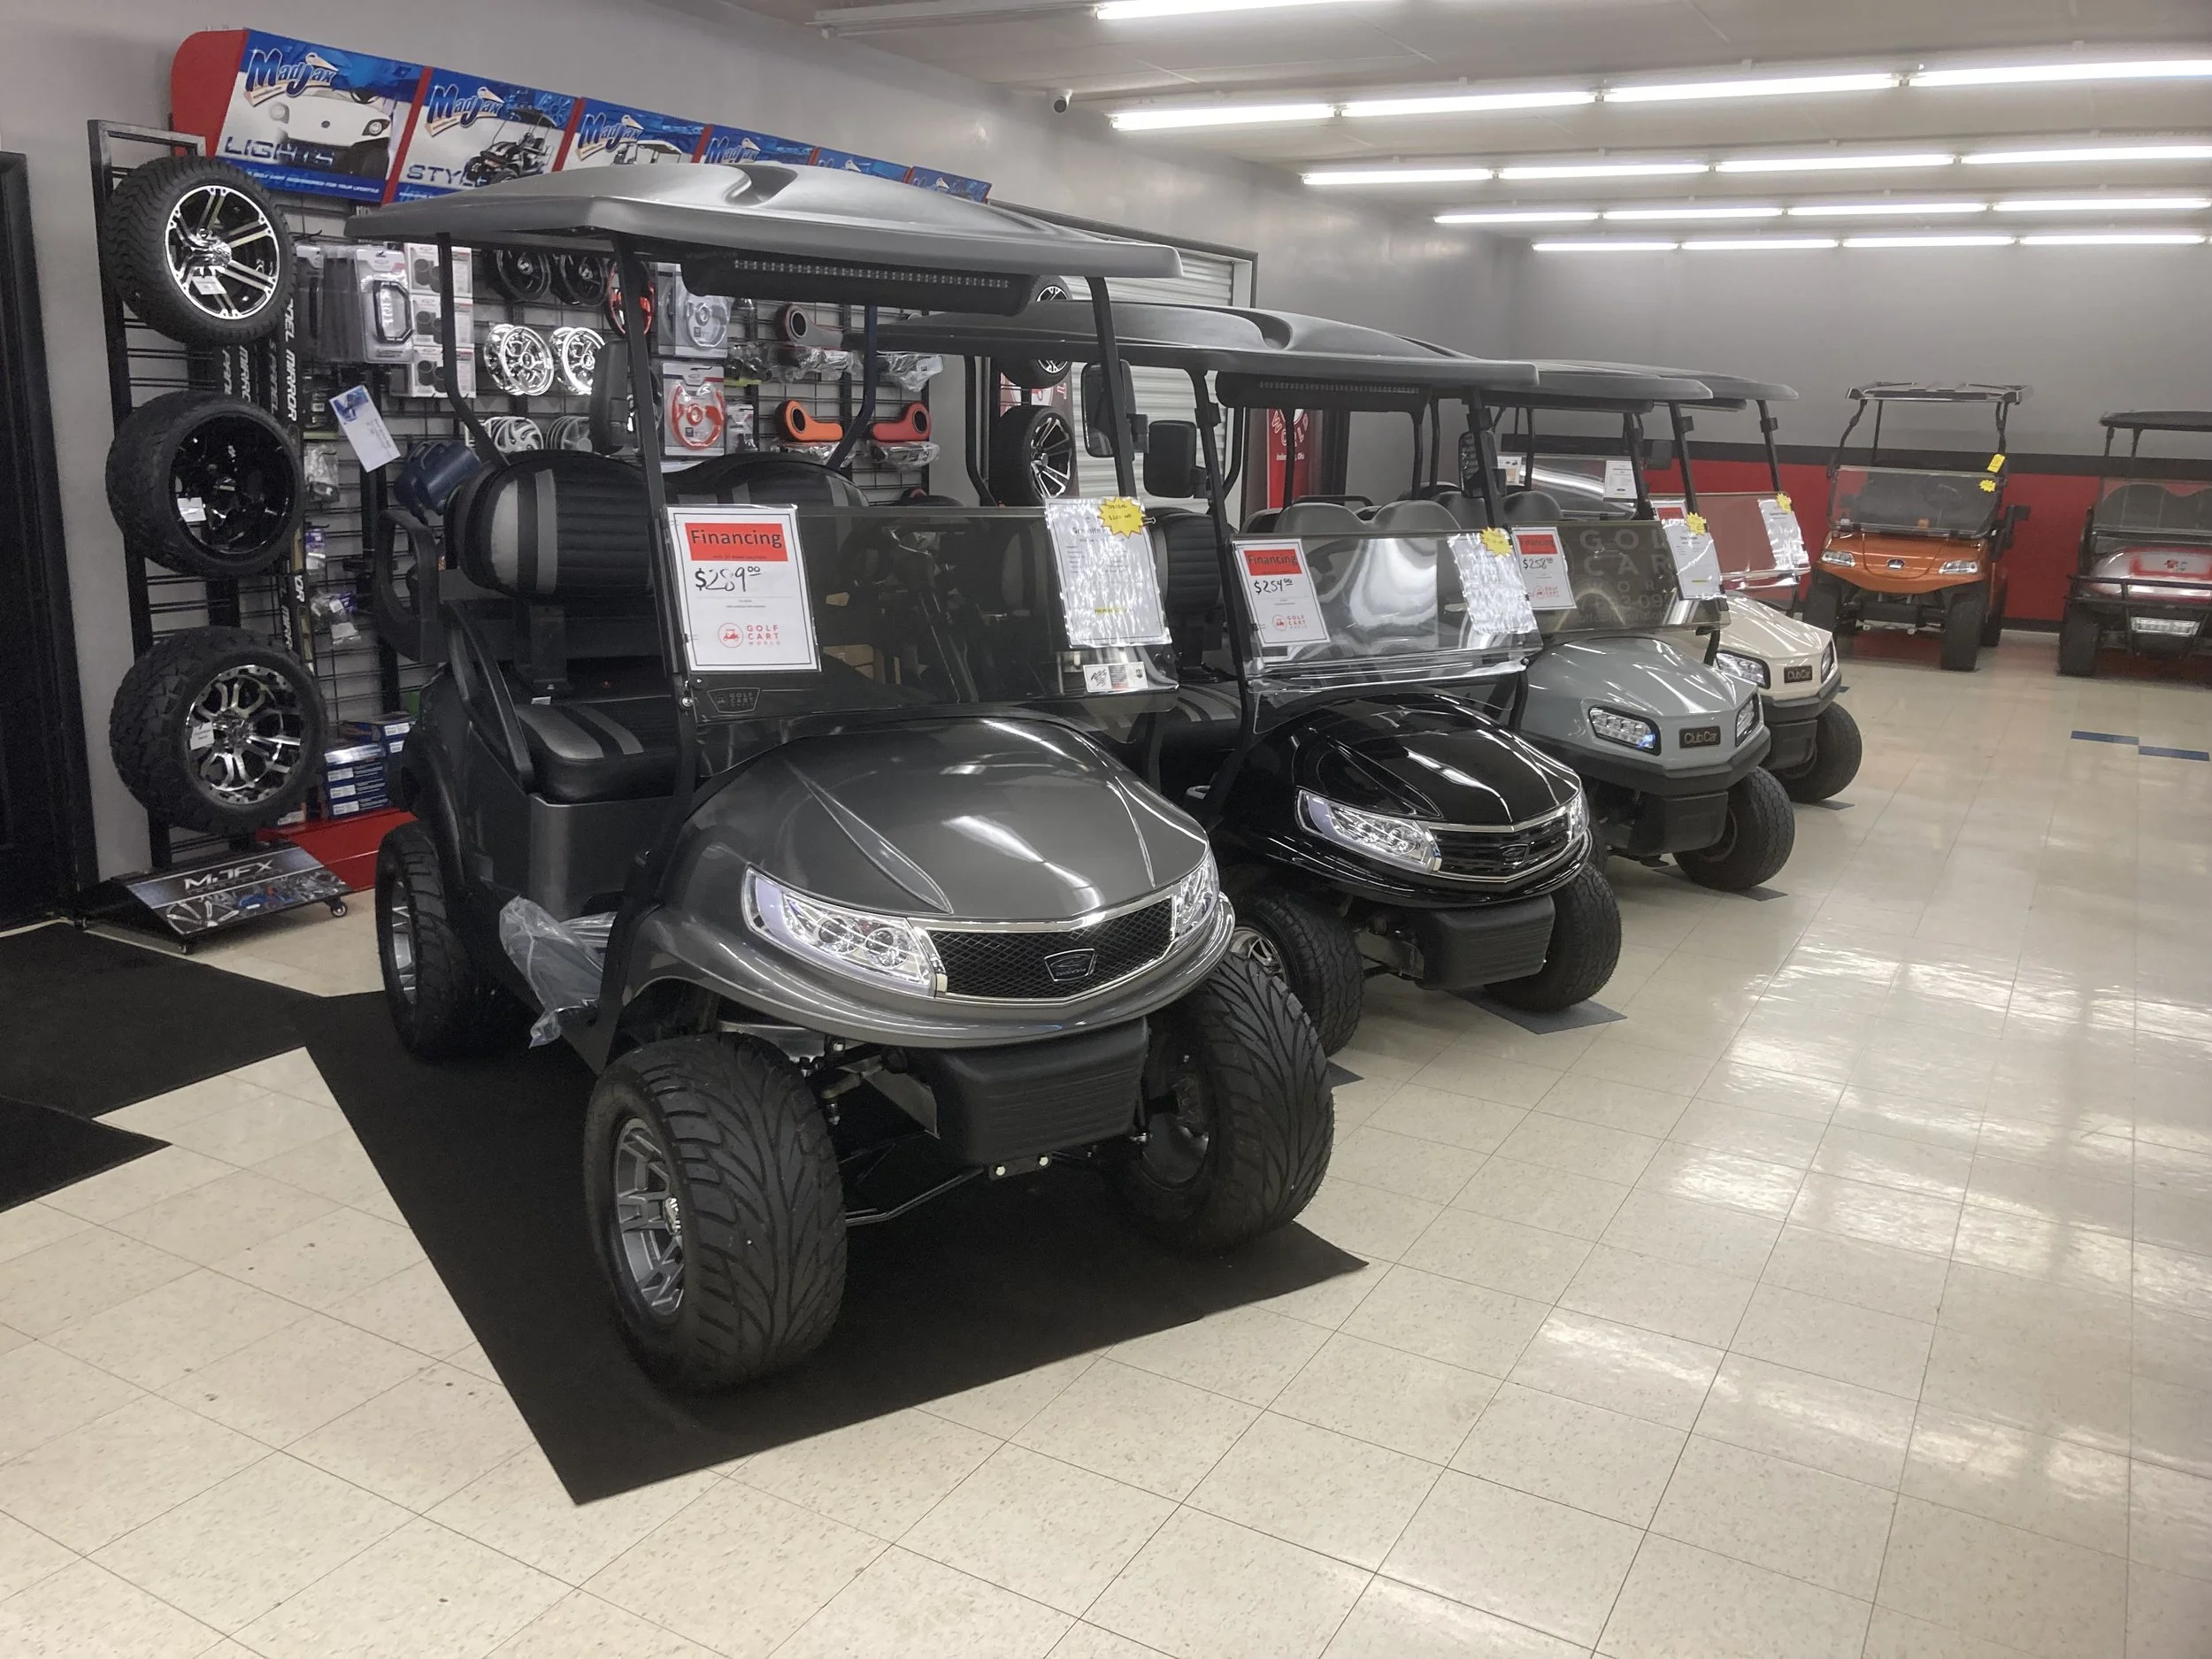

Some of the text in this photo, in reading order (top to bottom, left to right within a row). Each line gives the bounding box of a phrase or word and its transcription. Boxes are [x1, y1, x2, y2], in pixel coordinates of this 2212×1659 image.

[245, 48, 337, 97] MadJax
[427, 84, 503, 128] MadJax
[691, 529, 782, 549] Financing
[1247, 555, 1298, 566] Financing
[1583, 553, 1669, 576] CAR
